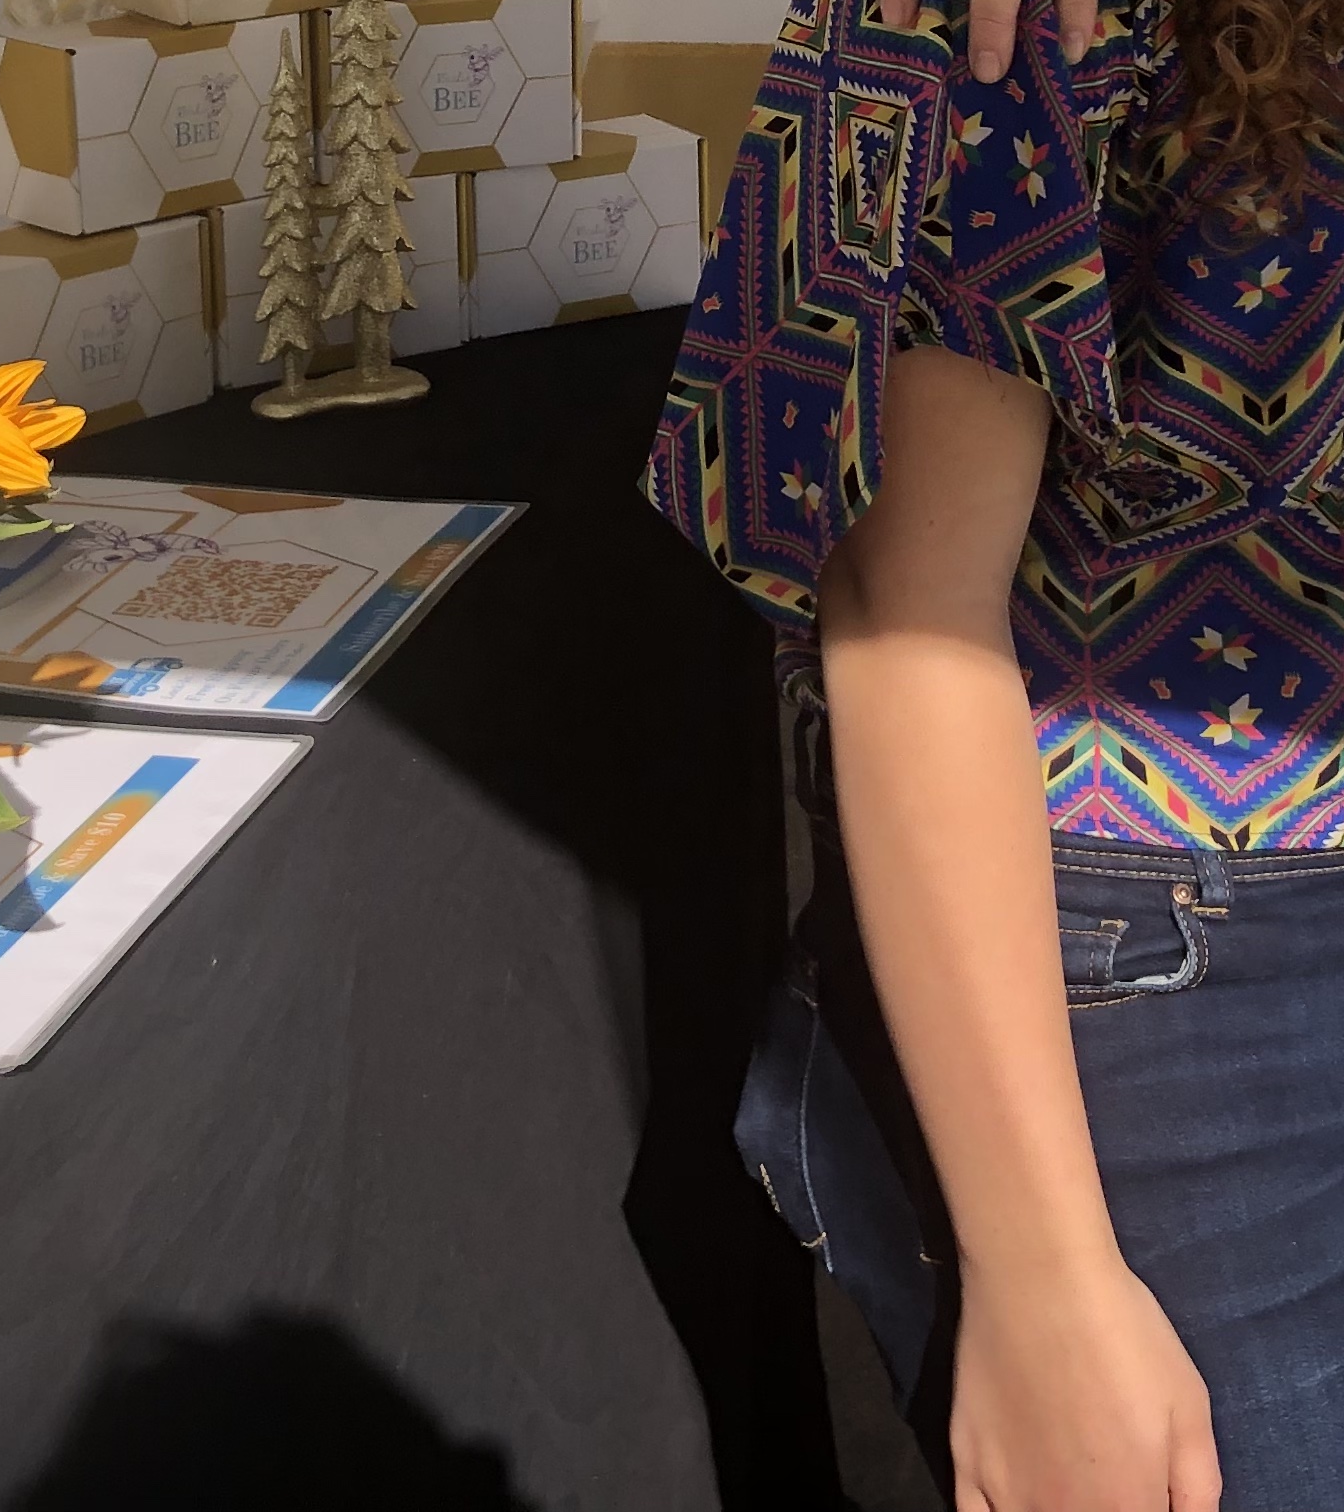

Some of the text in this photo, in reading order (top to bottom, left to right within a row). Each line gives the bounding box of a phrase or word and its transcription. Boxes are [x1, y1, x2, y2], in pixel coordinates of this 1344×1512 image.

[433, 87, 481, 111] BEE
[175, 121, 219, 148] BEE
[573, 240, 616, 264] BEE
[87, 812, 127, 837] $10
[54, 839, 100, 869] Save
[41, 872, 69, 884] &
